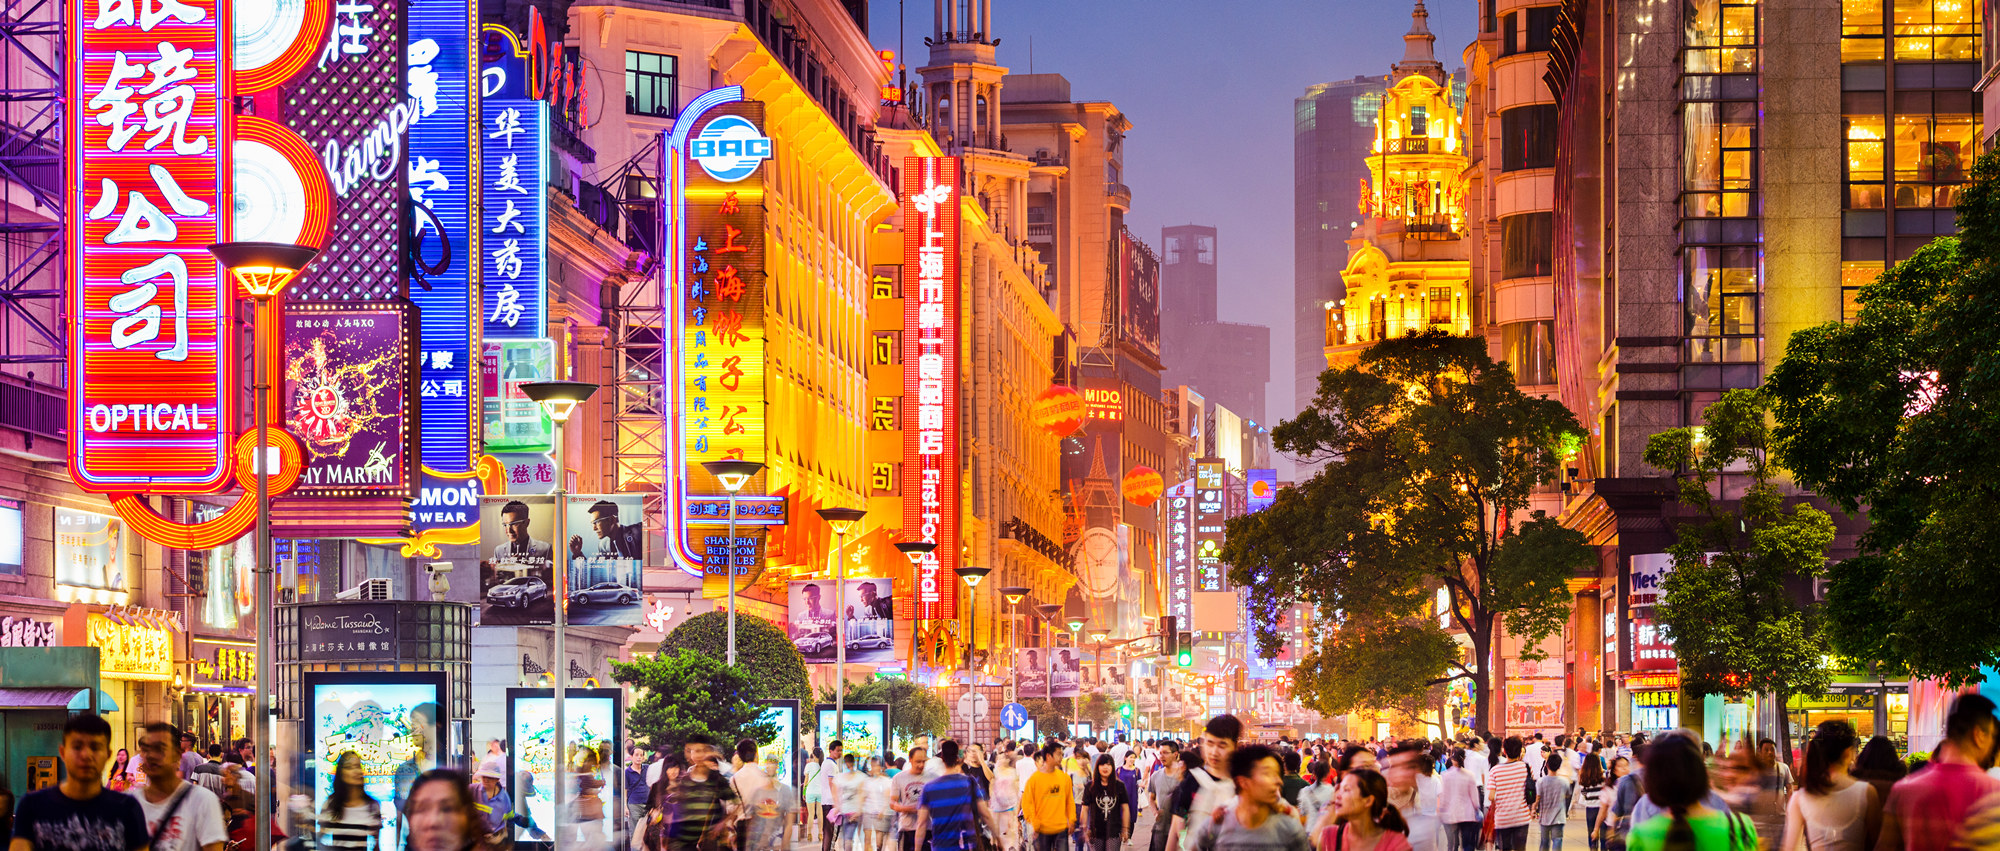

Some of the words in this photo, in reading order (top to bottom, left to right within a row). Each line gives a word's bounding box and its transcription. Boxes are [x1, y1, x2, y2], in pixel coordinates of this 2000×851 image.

[691, 139, 770, 158] BAC
[489, 107, 530, 330] 华美大药房
[691, 236, 710, 452] 上海卧室用品有限公司
[918, 227, 945, 454] 上海市第一食品商店
[1085, 389, 1120, 404] MIDO
[90, 403, 208, 433] OPTICAL
[326, 464, 393, 484] MARTIN
[505, 463, 552, 485] 慈菴
[921, 469, 940, 506] First
[419, 511, 468, 523] WEAR
[687, 503, 784, 517] 创建于1942年
[704, 536, 758, 546] SHANGHAI
[706, 546, 755, 555] BEDROOM
[706, 556, 755, 566] ARTICLES
[921, 512, 940, 602] Fodhall
[1205, 567, 1220, 590] 真丝
[304, 615, 338, 631] Madame
[335, 613, 384, 635] Tussauds
[304, 641, 390, 653] 上海杜莎夫人蜡像馆
[1825, 693, 1847, 703] 3090
